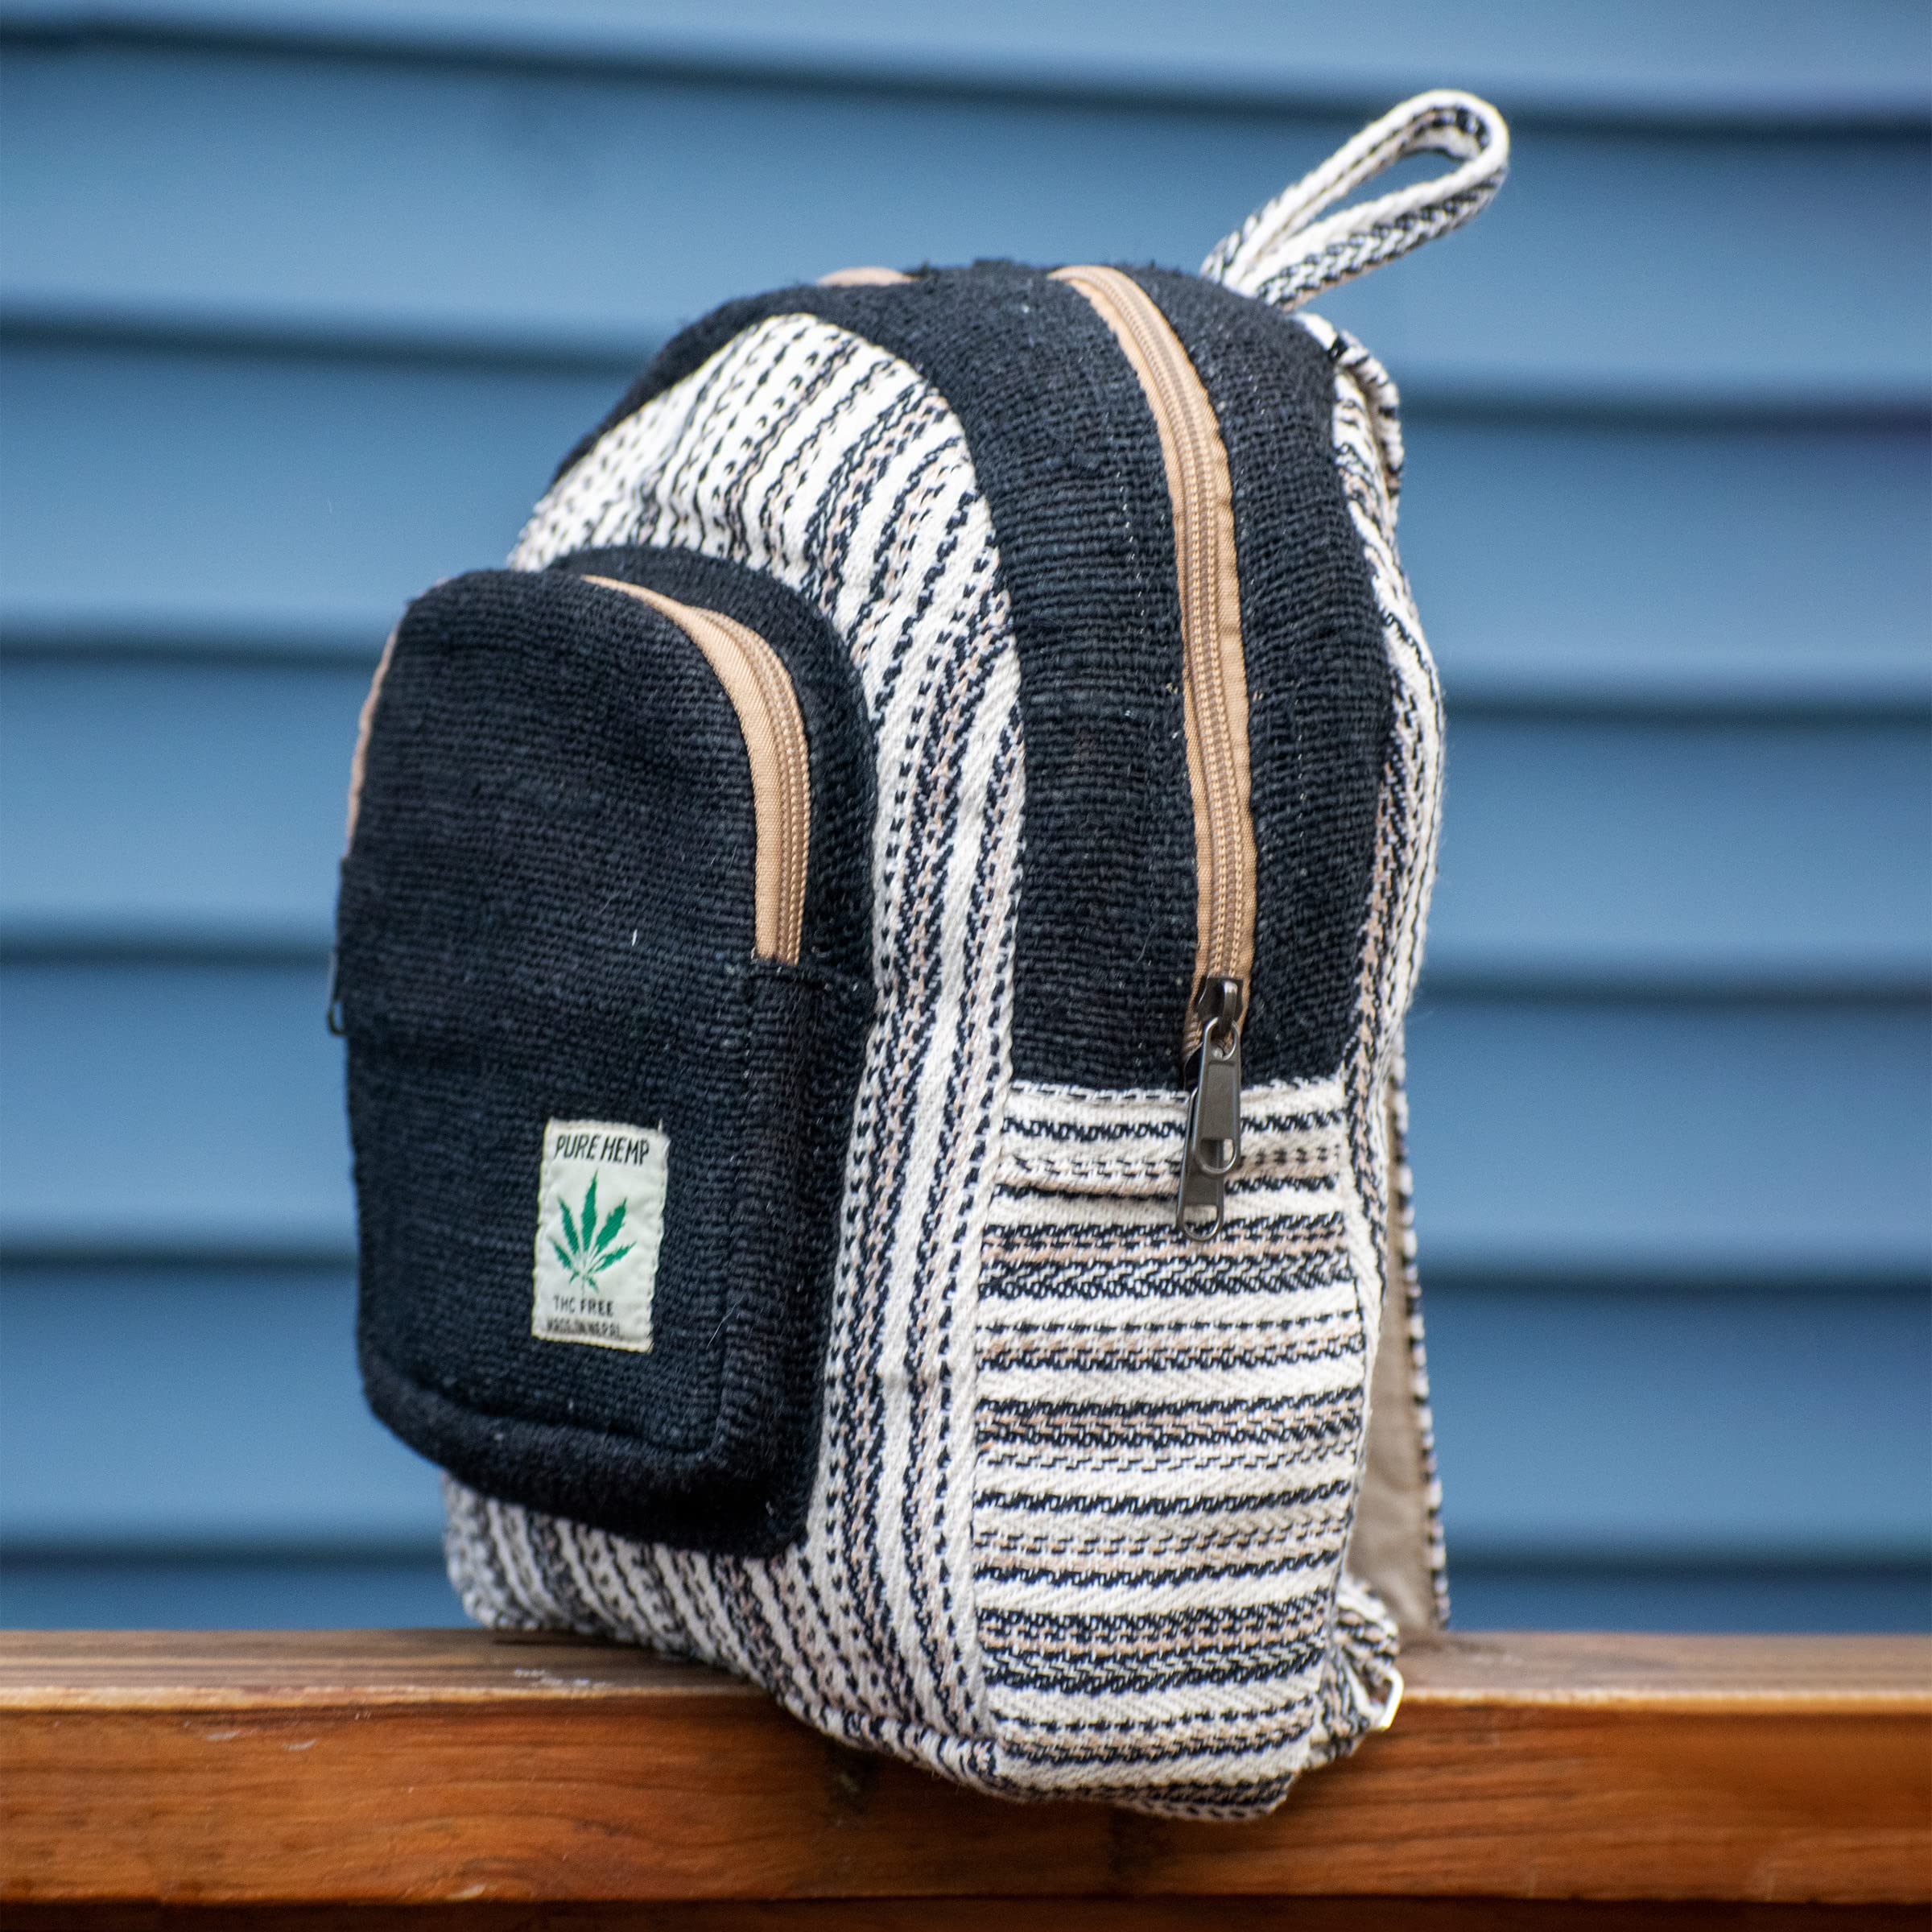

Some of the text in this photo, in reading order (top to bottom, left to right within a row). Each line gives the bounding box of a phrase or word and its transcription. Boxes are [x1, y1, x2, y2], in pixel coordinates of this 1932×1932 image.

[555, 1134, 650, 1165] PURE HEMP
[554, 1296, 613, 1317] THC FREE
